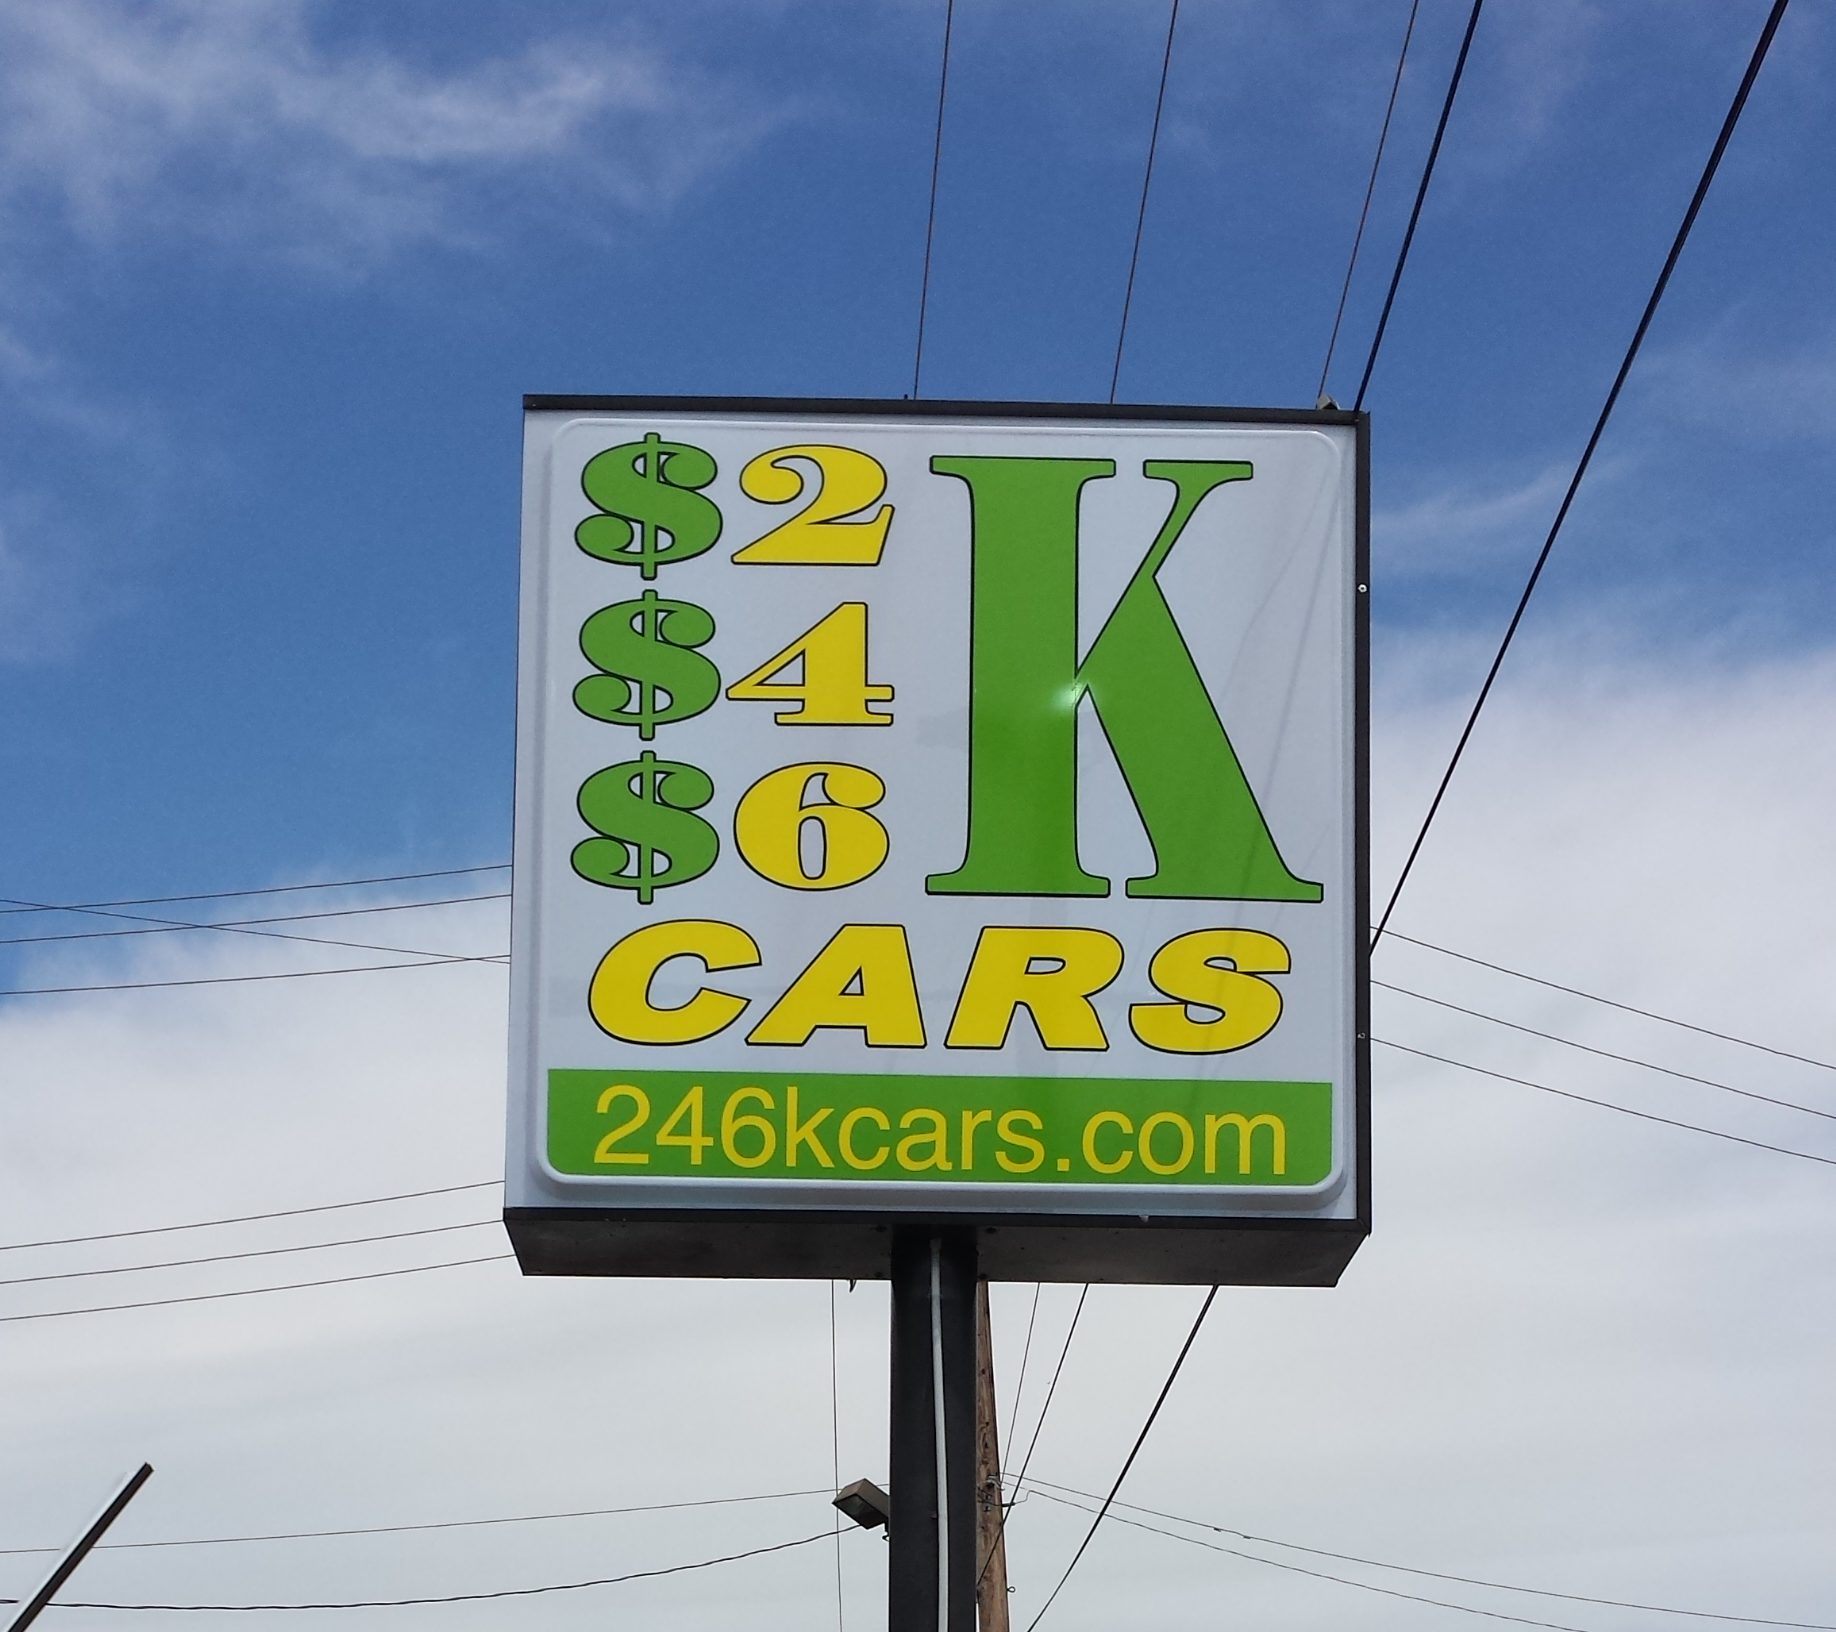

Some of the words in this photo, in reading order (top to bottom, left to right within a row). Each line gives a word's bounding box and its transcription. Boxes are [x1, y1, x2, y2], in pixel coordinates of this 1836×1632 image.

[575, 432, 895, 579] $2
[572, 589, 895, 740] $4
[925, 455, 1324, 903] K
[570, 750, 890, 904] $6
[587, 918, 1293, 1055] CARS
[593, 1083, 1287, 1177] 246kcars.com
